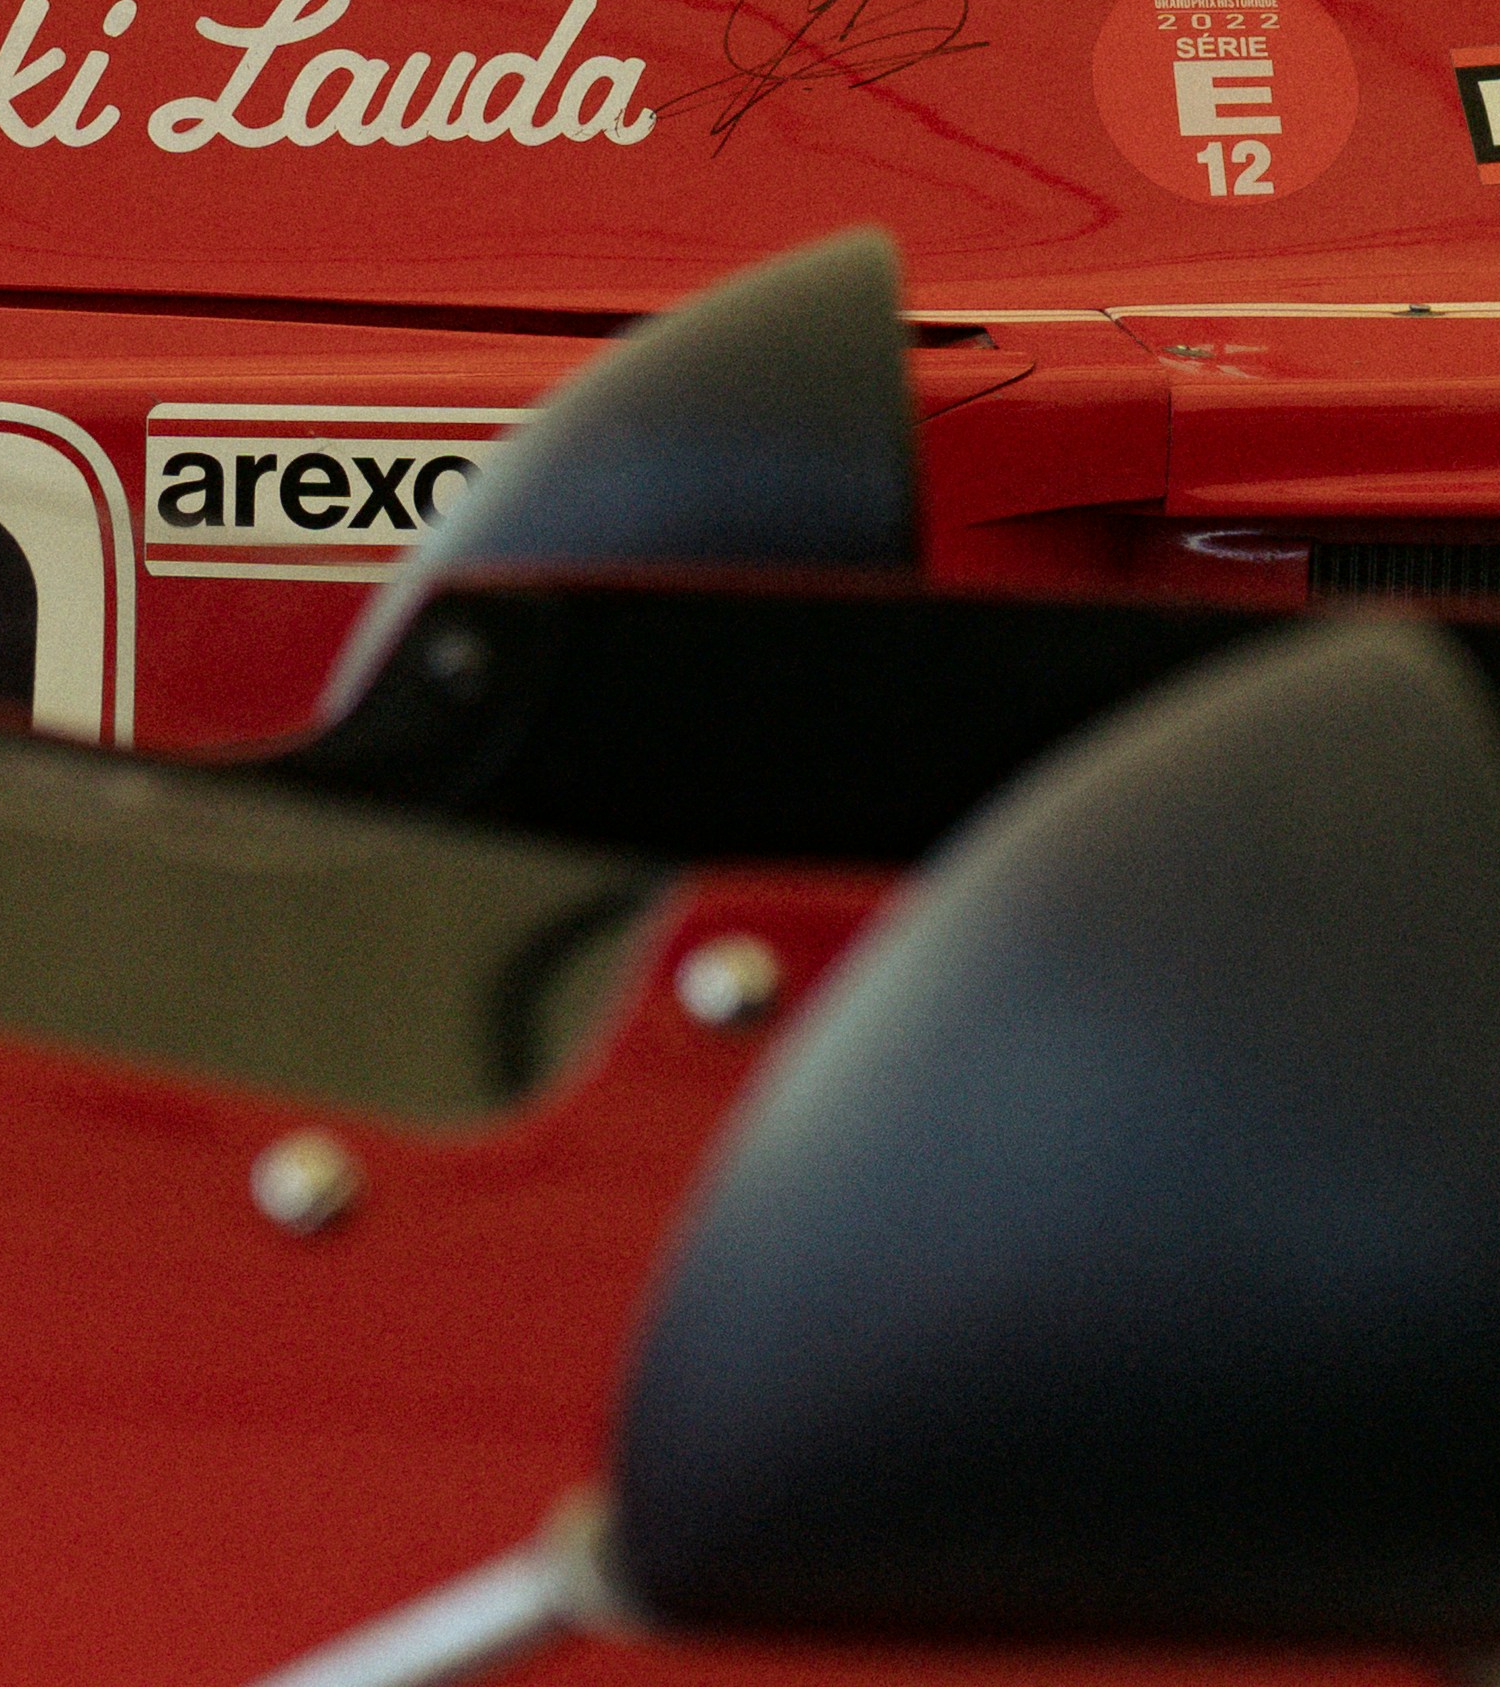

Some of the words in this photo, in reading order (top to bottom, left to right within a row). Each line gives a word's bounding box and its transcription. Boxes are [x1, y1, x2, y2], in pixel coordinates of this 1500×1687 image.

[1176, 33, 1268, 59] SÉRIE
[1173, 60, 1283, 136] E
[1197, 140, 1275, 197] 12
